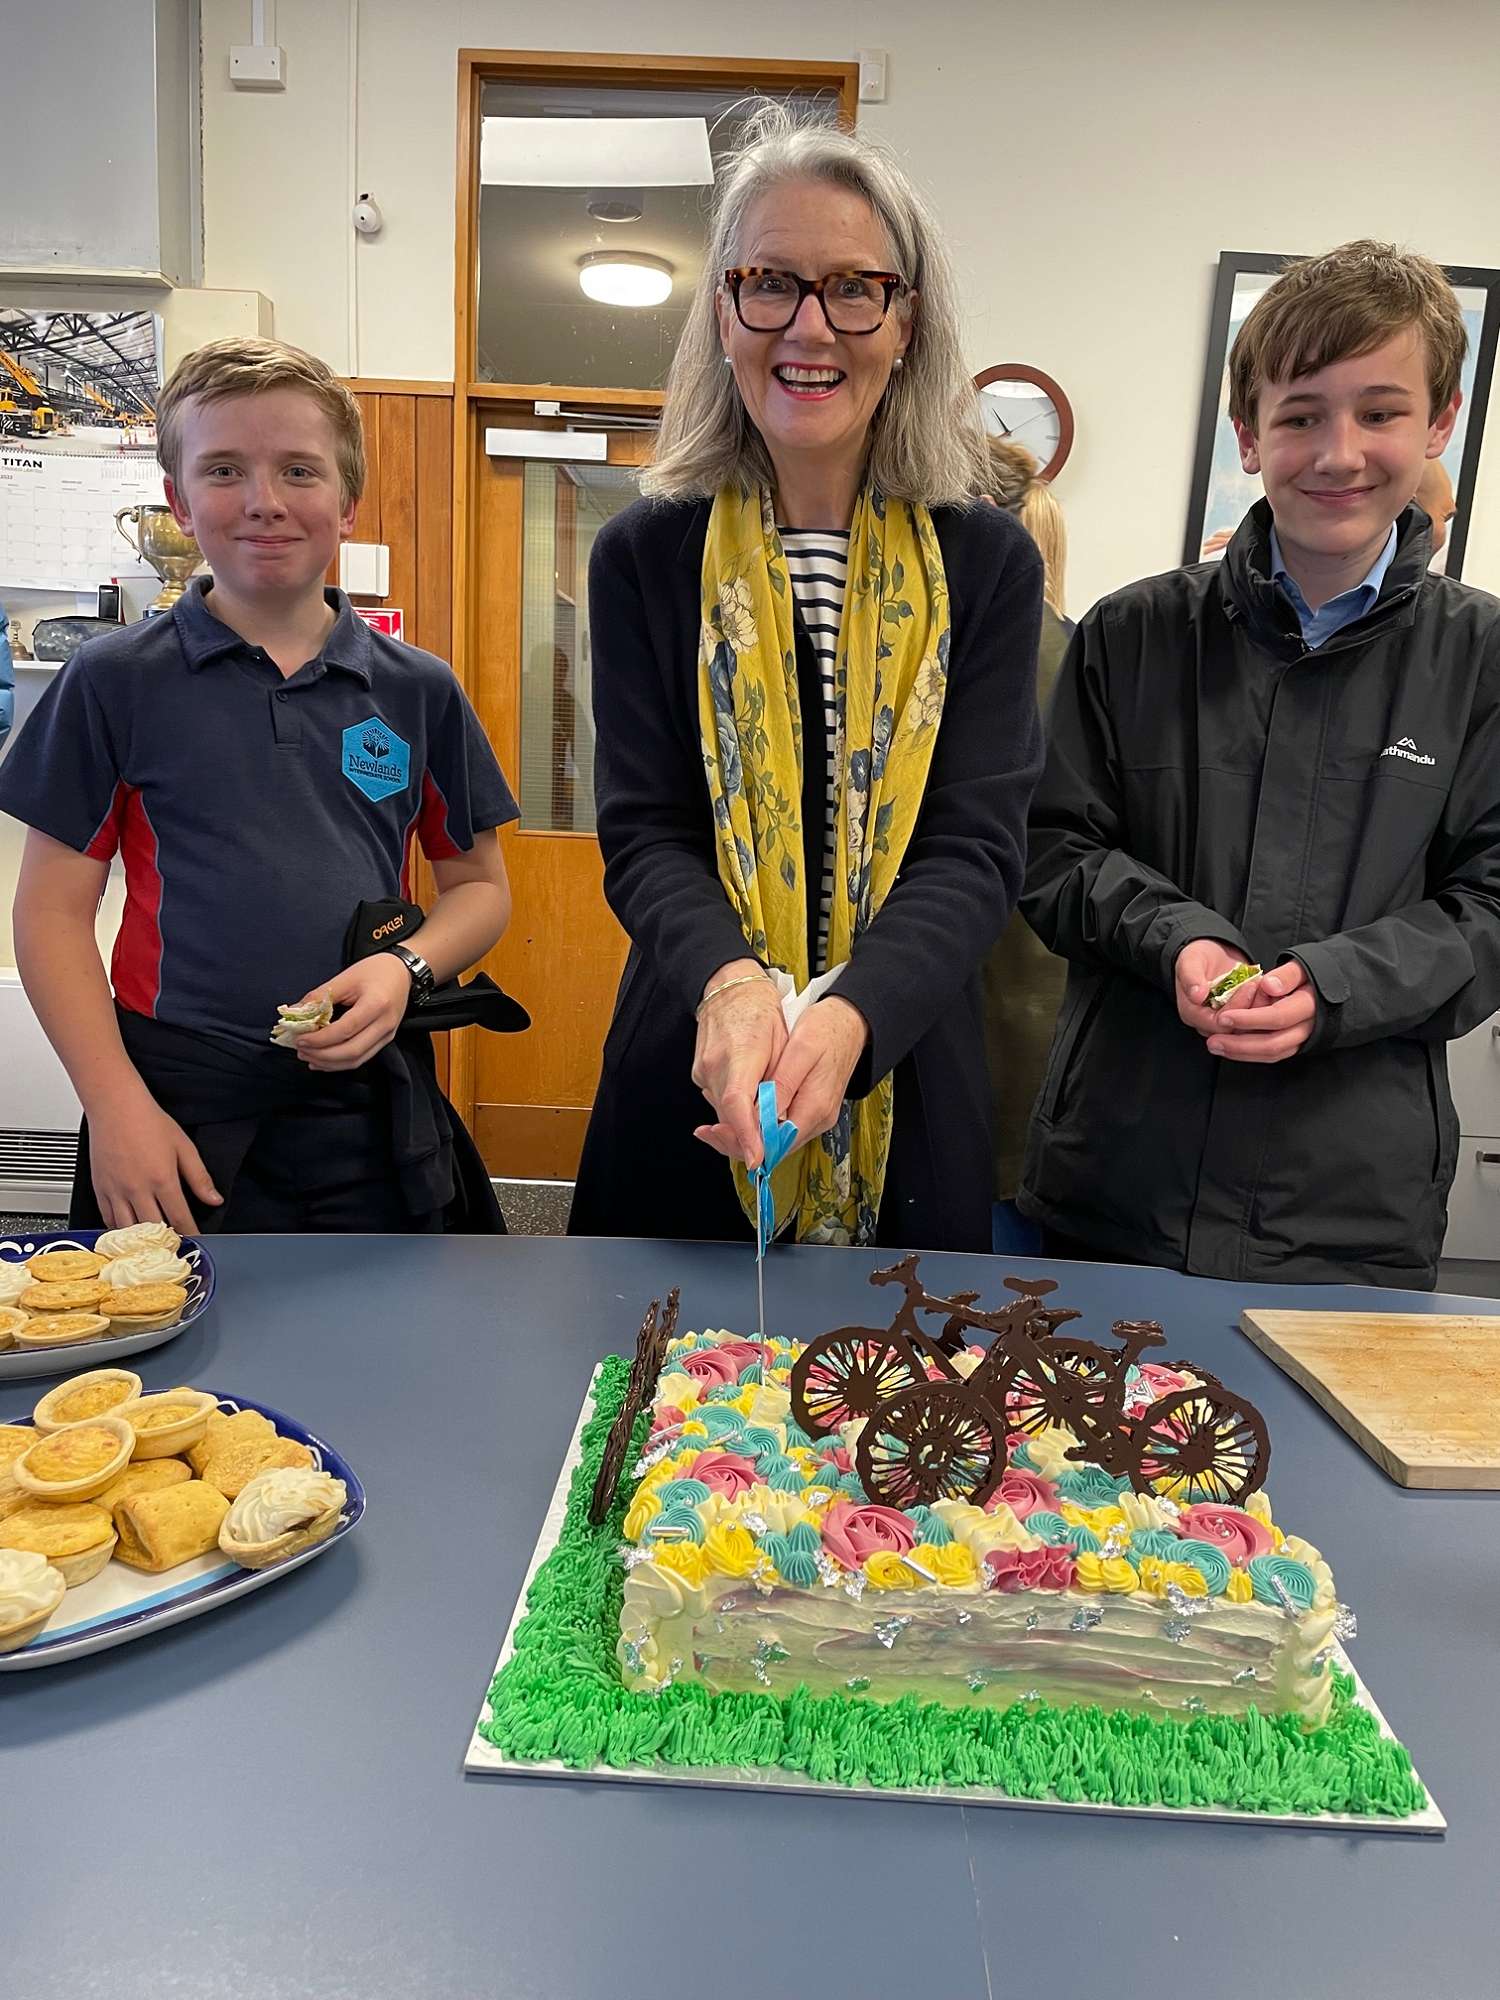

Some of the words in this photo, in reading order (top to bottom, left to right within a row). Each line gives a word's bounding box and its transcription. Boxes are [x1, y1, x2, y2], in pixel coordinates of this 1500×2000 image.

[2, 457, 43, 469] TITAN
[349, 753, 402, 777] Newlands
[1380, 745, 1436, 765] athmandu
[372, 914, 404, 940] OAKLEY
